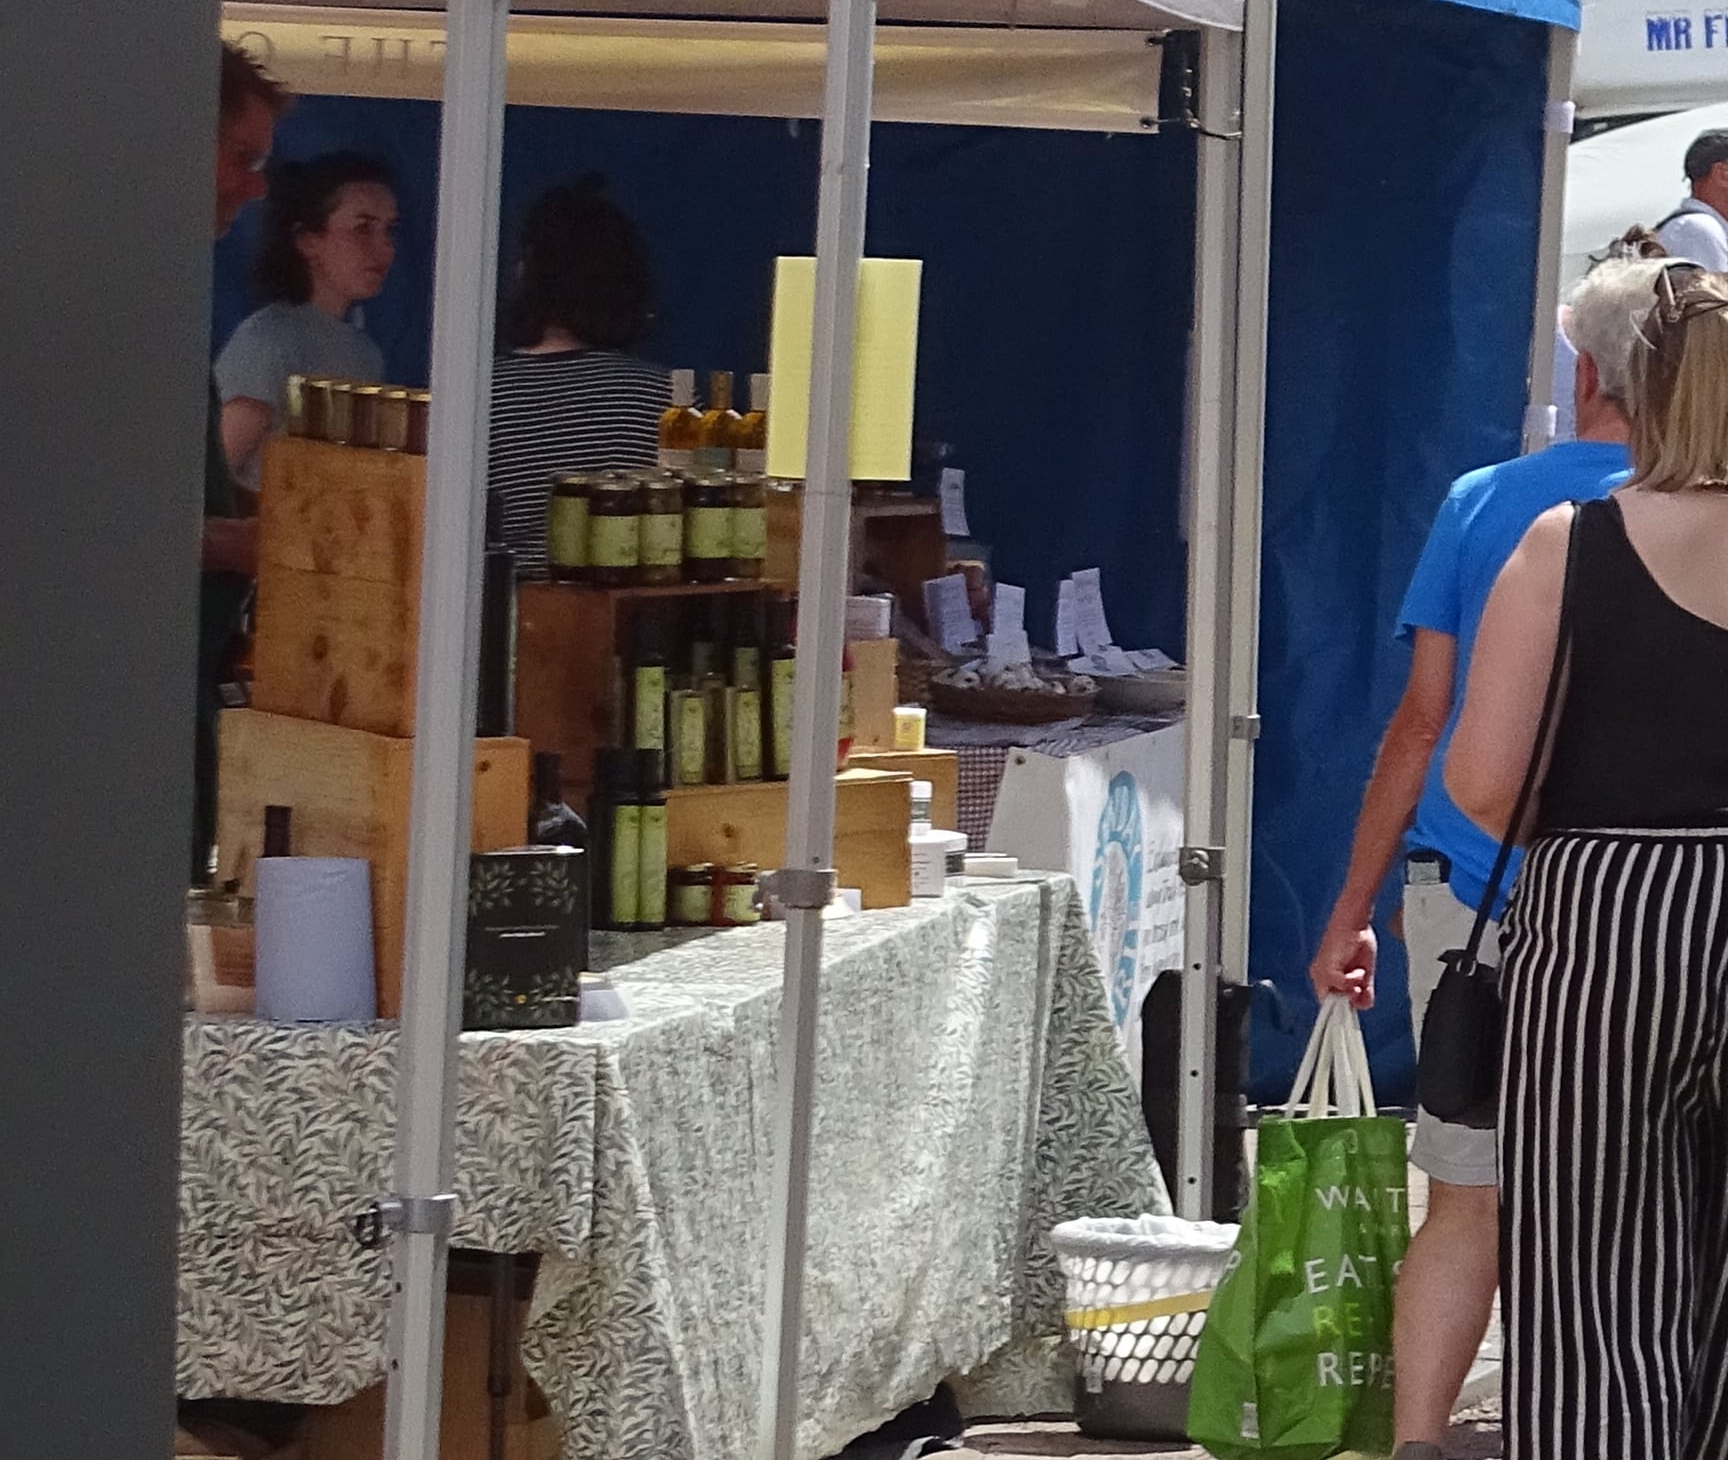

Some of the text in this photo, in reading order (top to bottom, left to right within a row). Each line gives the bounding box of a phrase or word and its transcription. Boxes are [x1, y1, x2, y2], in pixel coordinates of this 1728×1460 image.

[1646, 15, 1693, 52] MR
[1304, 1252, 1378, 1294] EAT
[1311, 1302, 1364, 1342] RE
